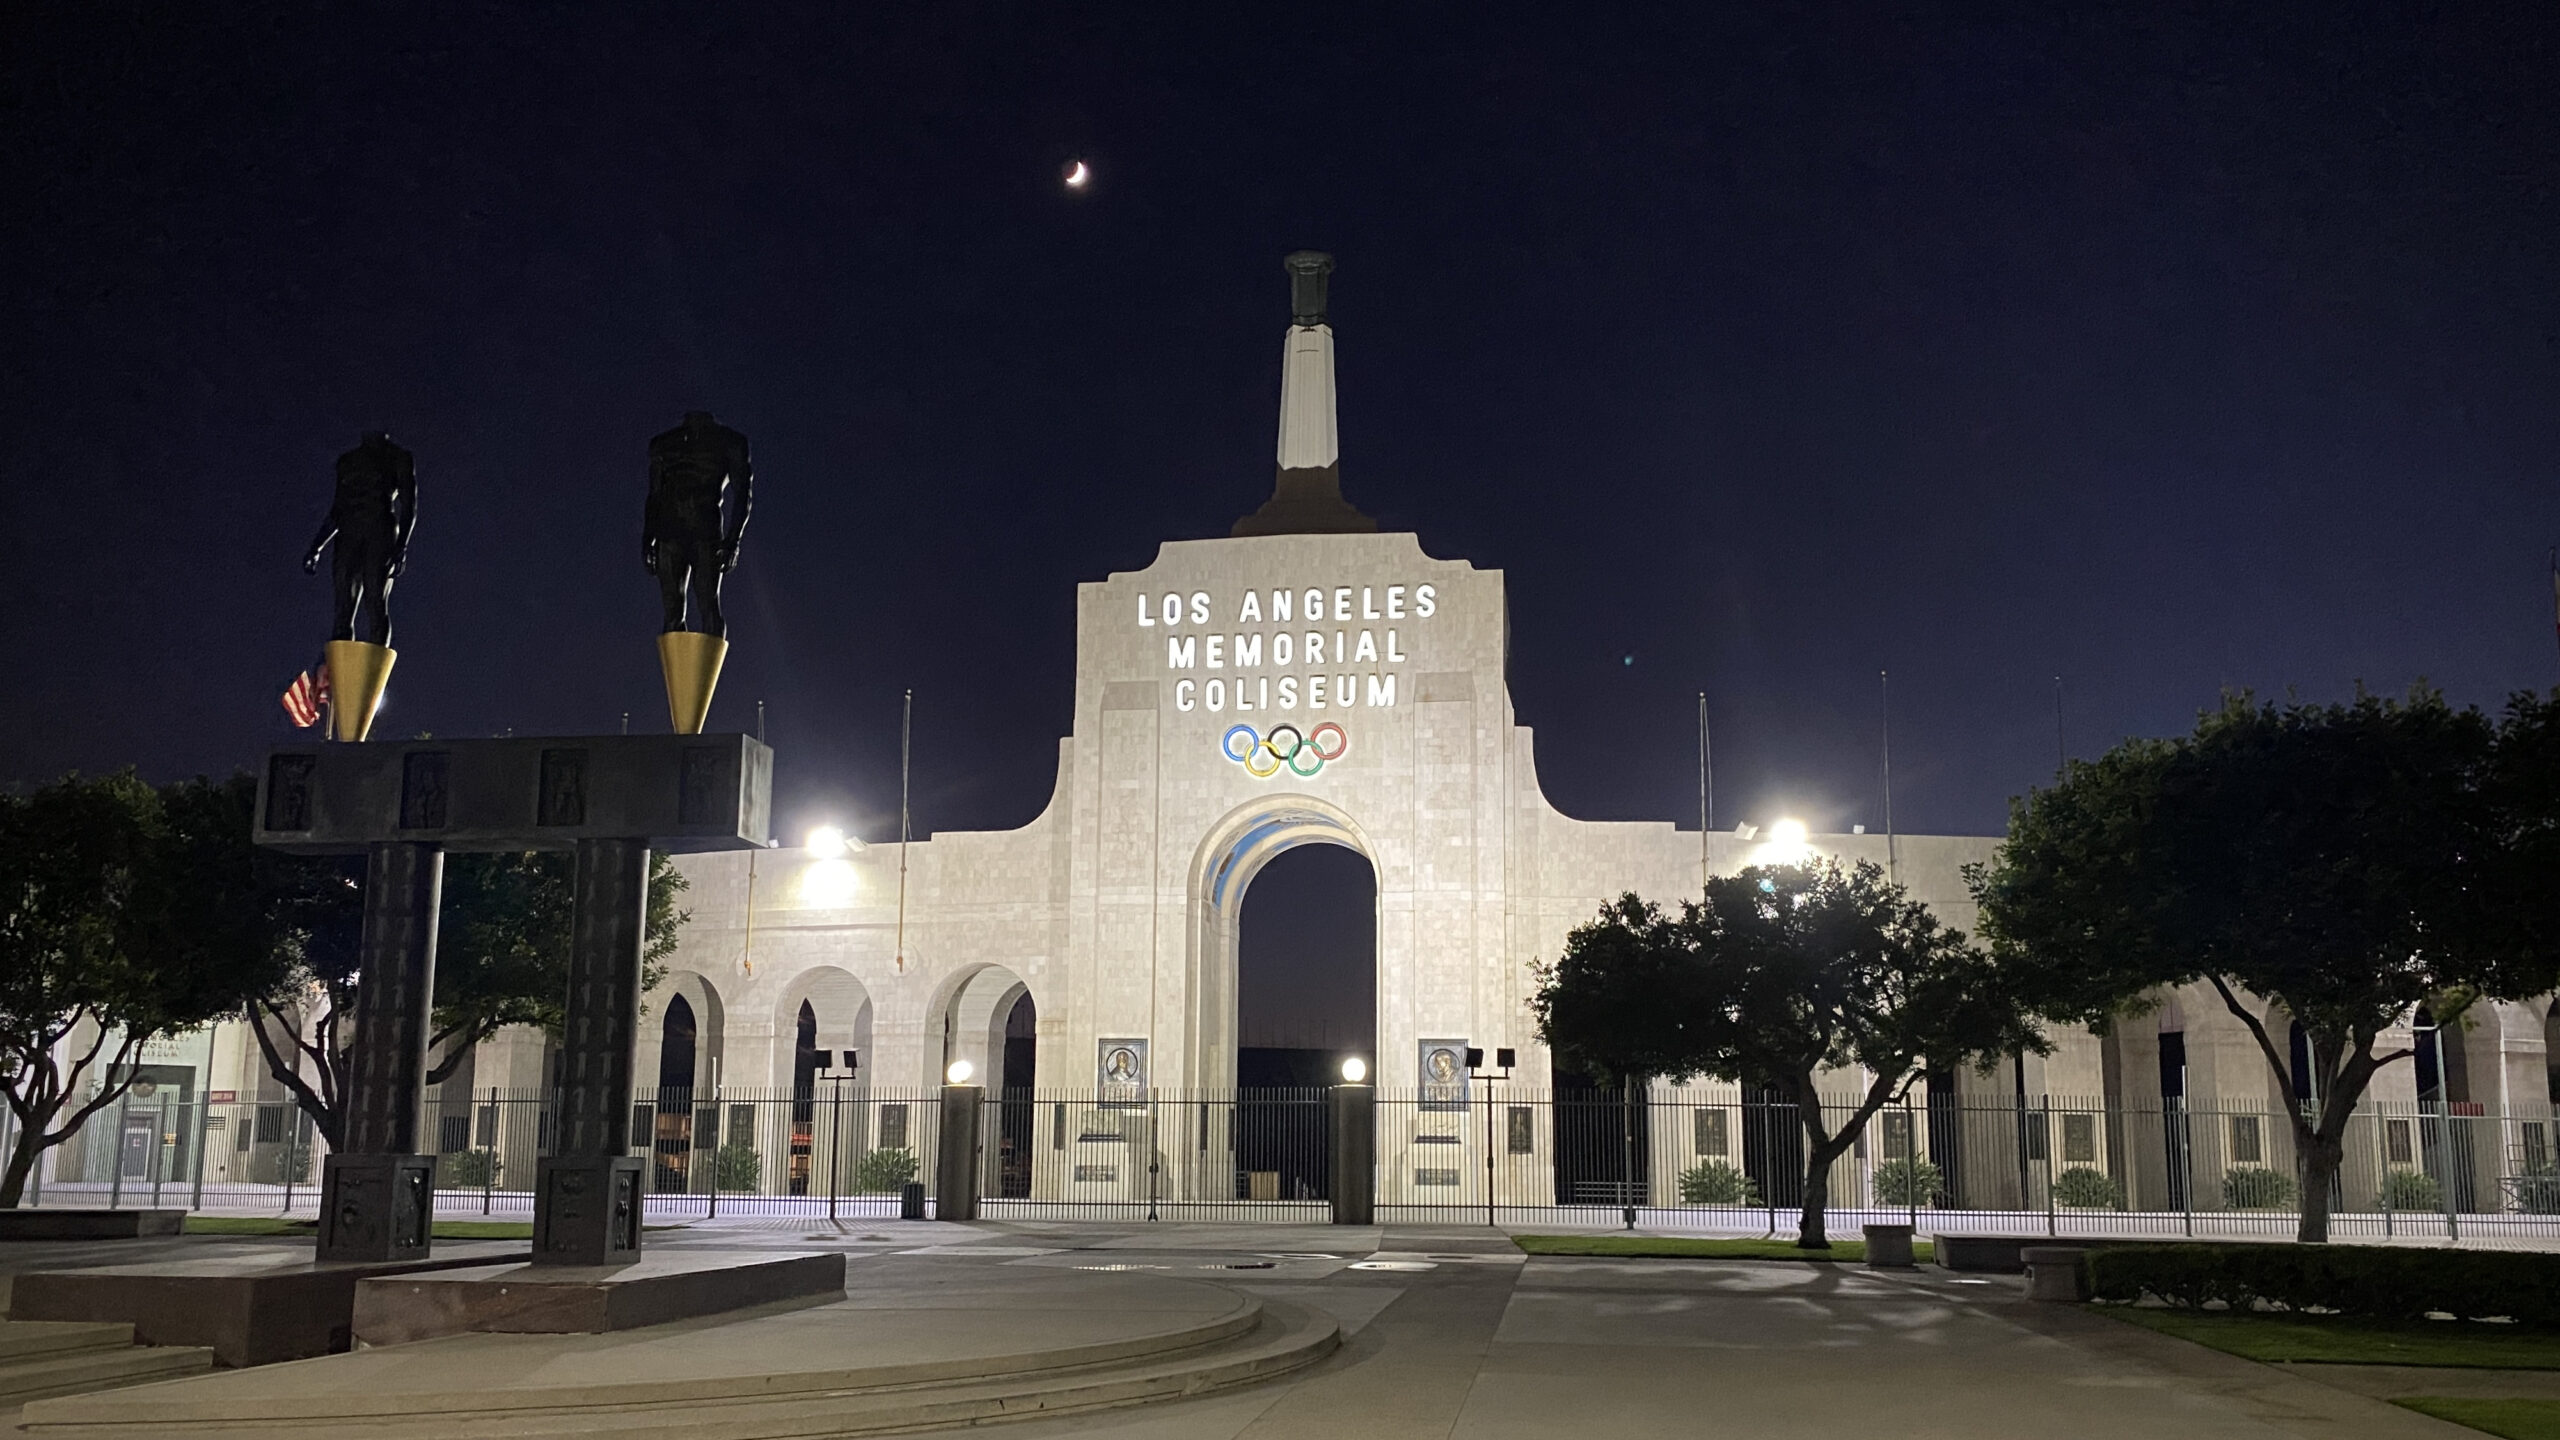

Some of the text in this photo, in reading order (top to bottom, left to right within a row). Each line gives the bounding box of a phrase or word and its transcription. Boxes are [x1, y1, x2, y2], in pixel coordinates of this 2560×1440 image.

[1138, 584, 1436, 627] LOS ANGELES
[1168, 629, 1406, 669] MEMORIAL
[1175, 673, 1396, 712] COLISEUM
